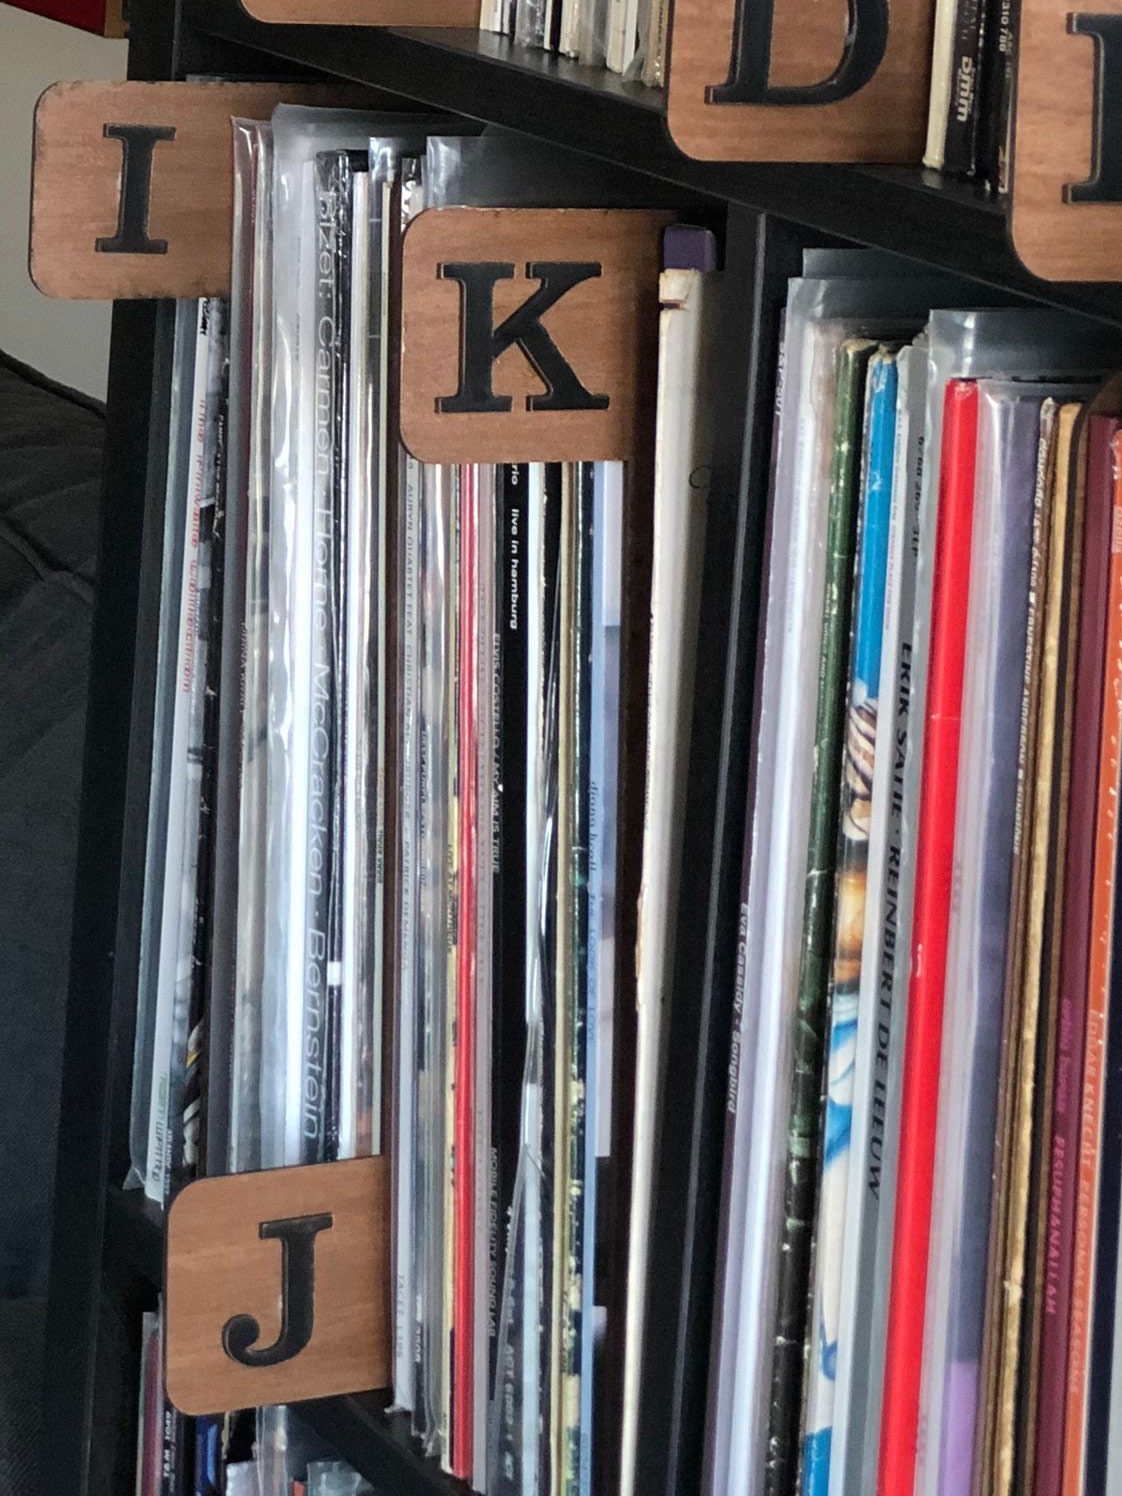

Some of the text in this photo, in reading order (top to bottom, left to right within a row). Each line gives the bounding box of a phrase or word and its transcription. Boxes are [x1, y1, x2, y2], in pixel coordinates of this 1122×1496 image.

[95, 124, 176, 254] I
[435, 261, 610, 413] K
[315, 315, 334, 474] Carmen
[313, 506, 333, 630] Horne
[511, 508, 520, 535] live
[511, 540, 520, 554] in
[182, 559, 201, 693] Collection
[508, 558, 520, 630] hamburg
[308, 661, 331, 894] McCracken
[491, 837, 499, 874] TRUE
[867, 642, 913, 1200] ERIK SATIE REINBERT DE LEEUW
[302, 927, 326, 1139] Bernstein
[727, 902, 749, 1113] Eva Cassidy Songbird
[1086, 1008, 1101, 1078] EDGAR
[490, 1147, 498, 1199] MOBILE
[1080, 1084, 1096, 1169] KNECHT
[489, 1201, 498, 1257] FIDELITY
[489, 1258, 497, 1307] SOUND
[1073, 1181, 1091, 1290] PERSONAL
[222, 1213, 332, 1367] J
[488, 1309, 496, 1337] LAB
